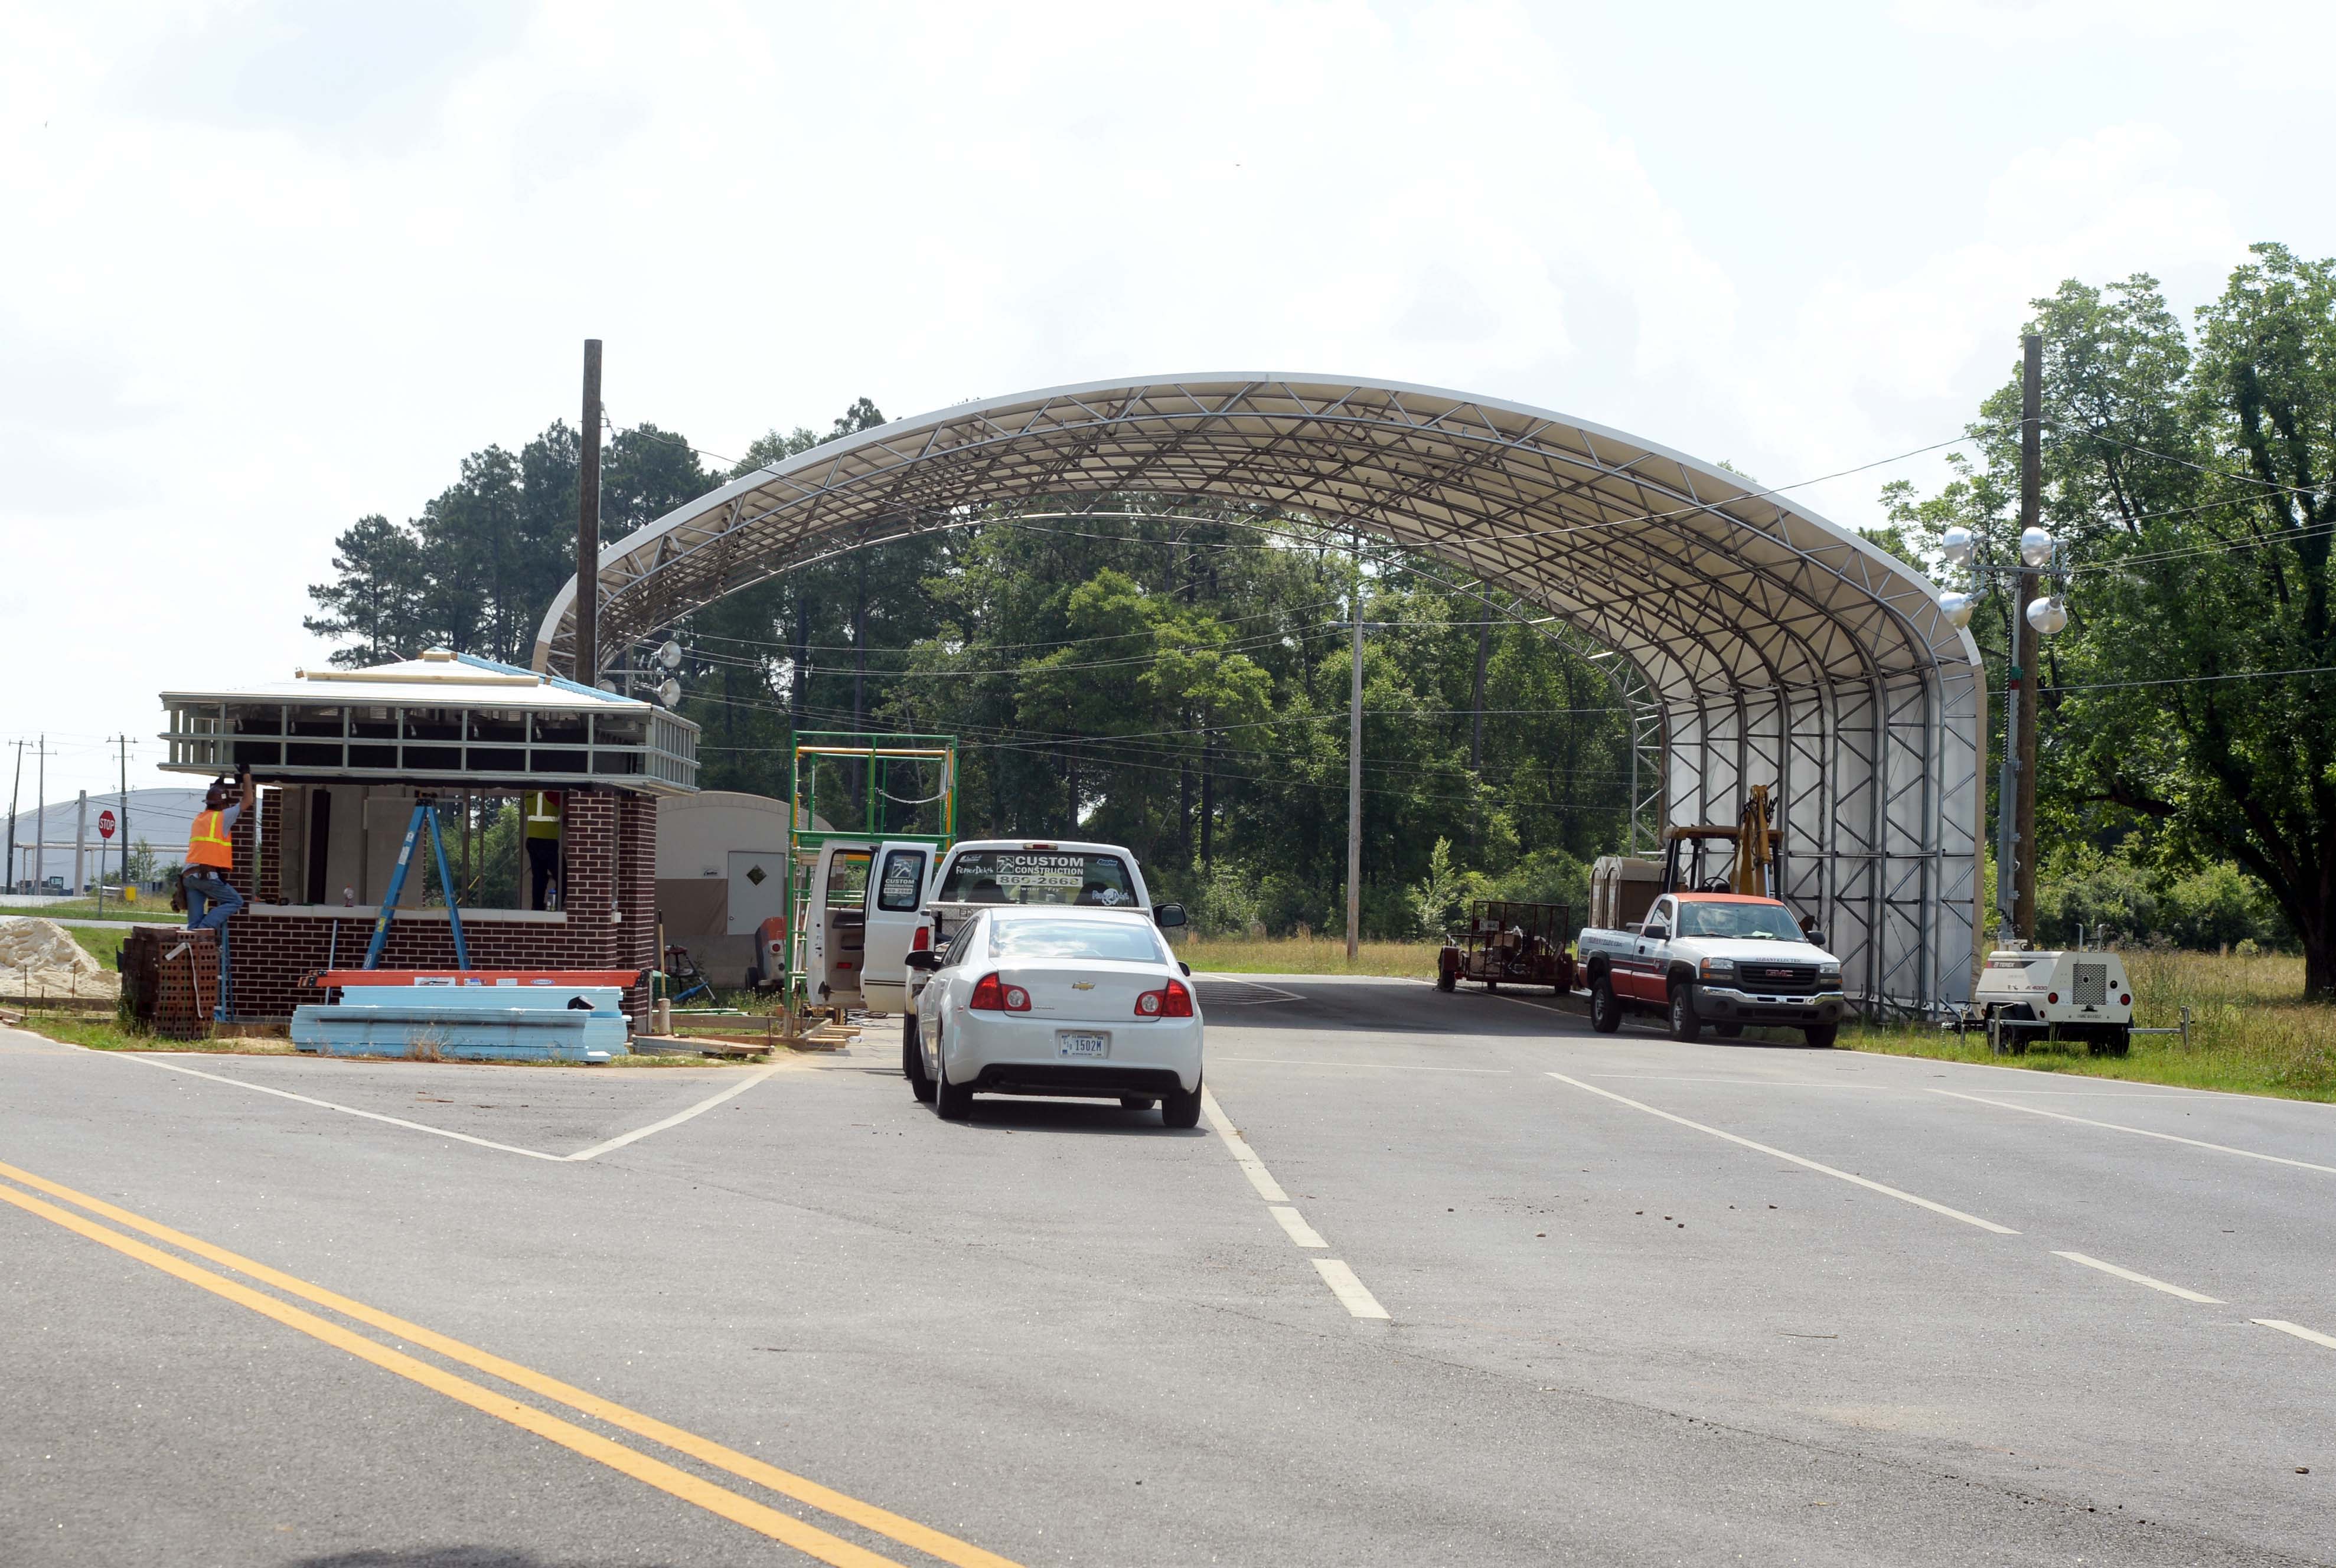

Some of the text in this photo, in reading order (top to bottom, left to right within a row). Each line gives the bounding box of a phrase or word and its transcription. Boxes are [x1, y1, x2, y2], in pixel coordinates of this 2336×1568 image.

[99, 818, 115, 830] STOP
[1015, 856, 1084, 867] CUSTOM
[1015, 867, 1084, 875] CONSTRUCTION
[1075, 1040, 1101, 1051] 1502M
